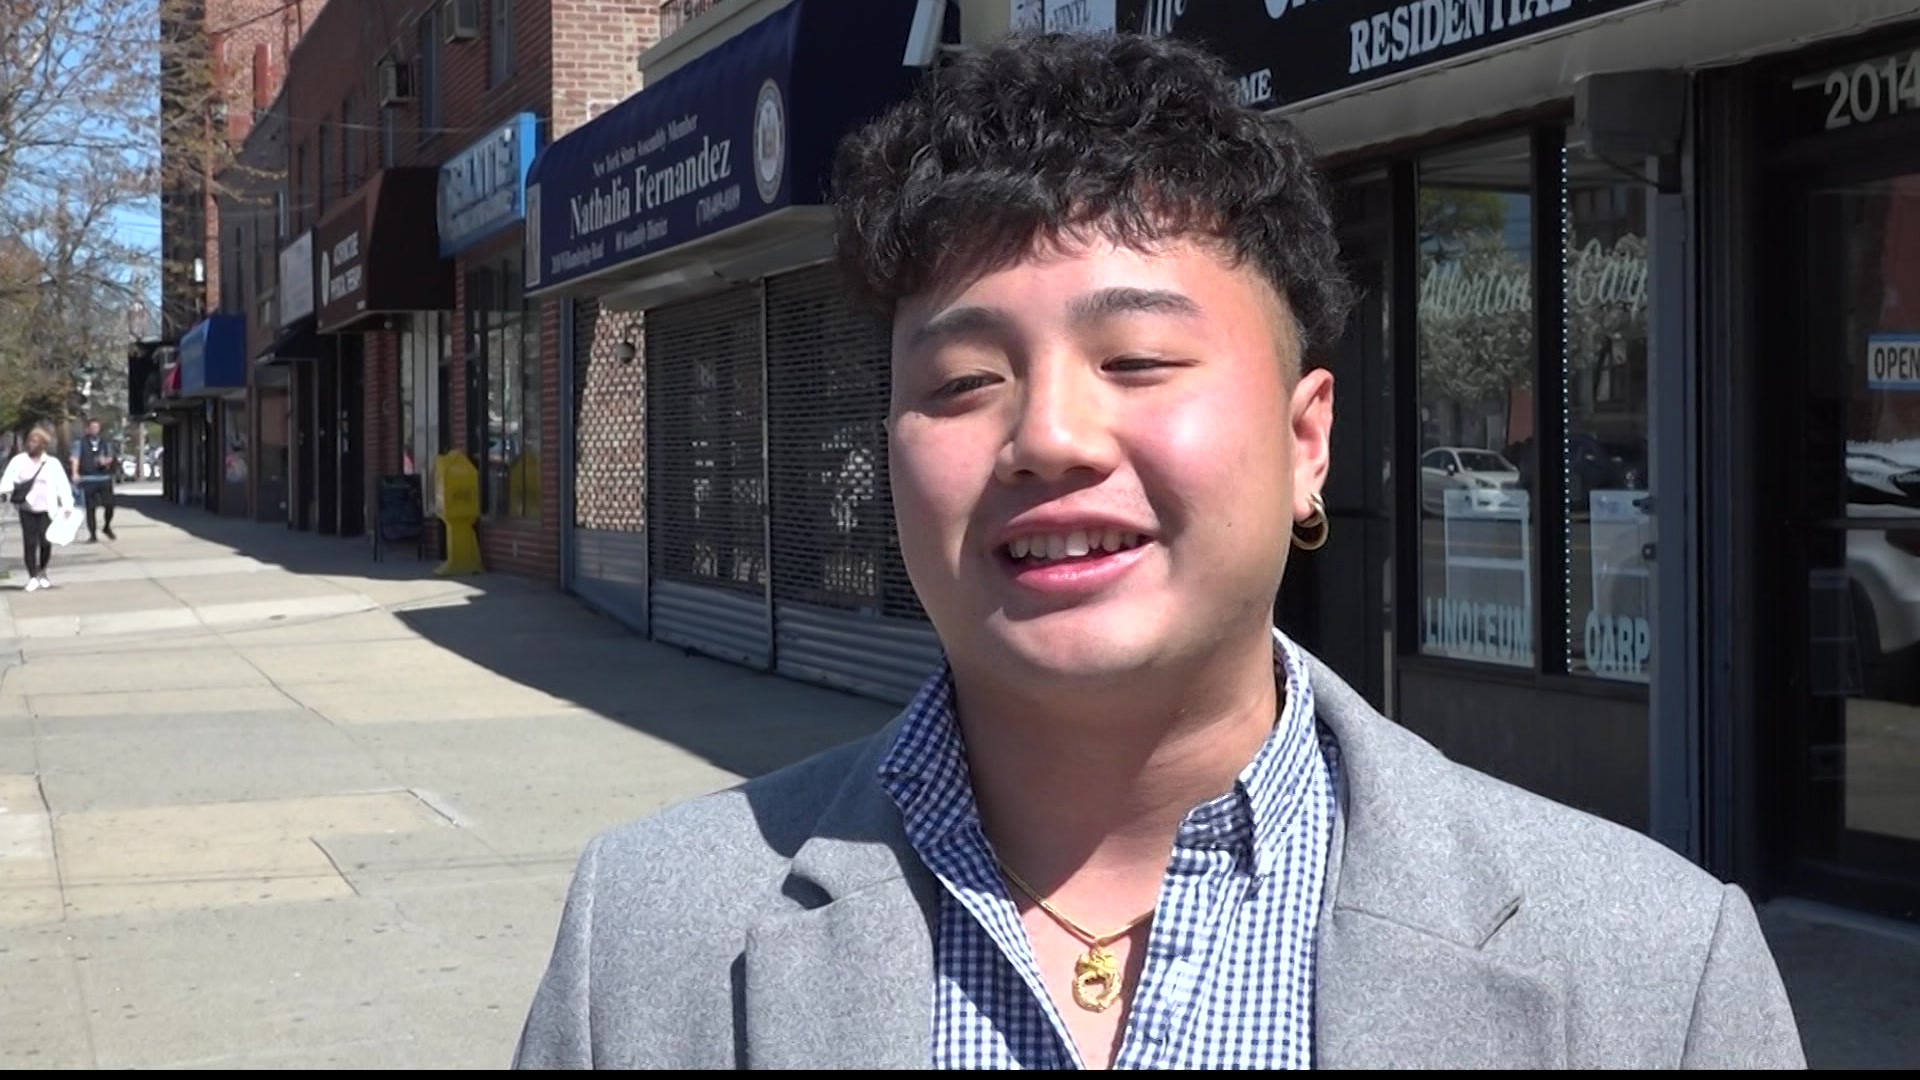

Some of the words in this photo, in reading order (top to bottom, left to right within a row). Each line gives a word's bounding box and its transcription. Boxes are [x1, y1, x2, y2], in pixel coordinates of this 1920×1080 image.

[1349, 0, 1572, 74] RESIDENTI
[1824, 51, 1920, 130] 2014
[570, 175, 630, 240] Nathalia
[635, 135, 732, 214] Fernandez
[1874, 346, 1920, 380] OPEN
[1426, 597, 1532, 662] LINOLEUM
